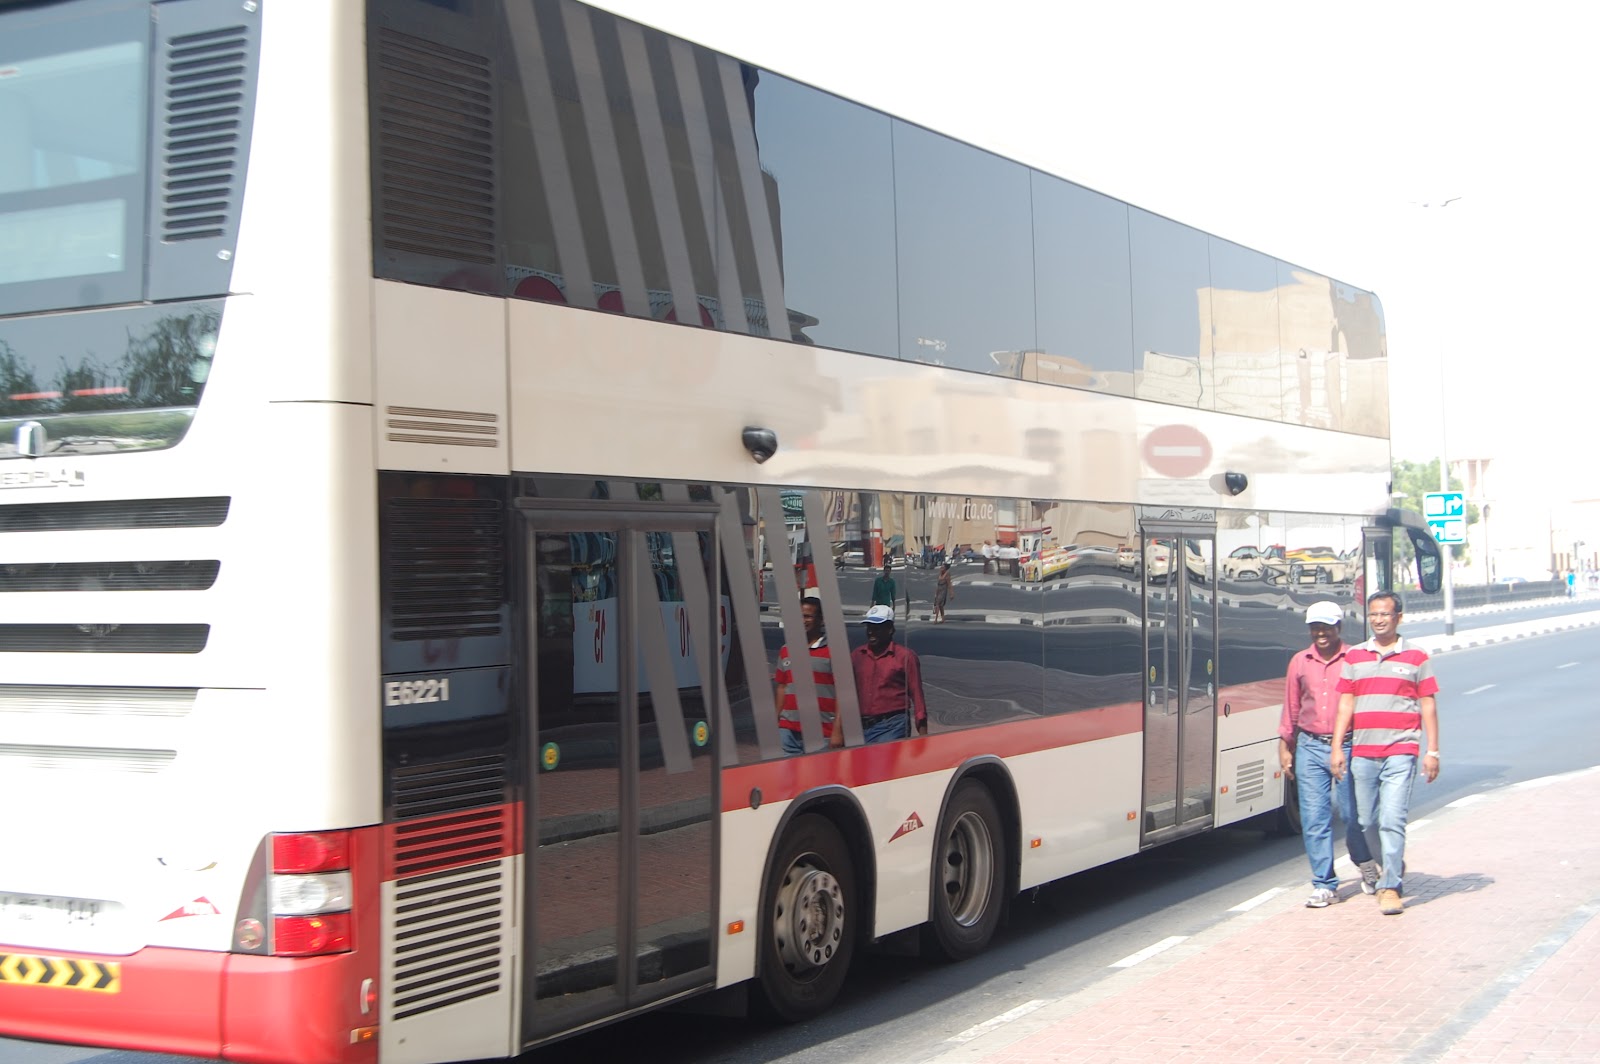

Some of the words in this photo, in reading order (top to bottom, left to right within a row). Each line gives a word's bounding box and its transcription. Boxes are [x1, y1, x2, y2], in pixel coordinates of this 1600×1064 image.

[928, 499, 994, 520] www.rta.ae
[385, 678, 449, 707] E6221
[903, 819, 918, 832] RTA
